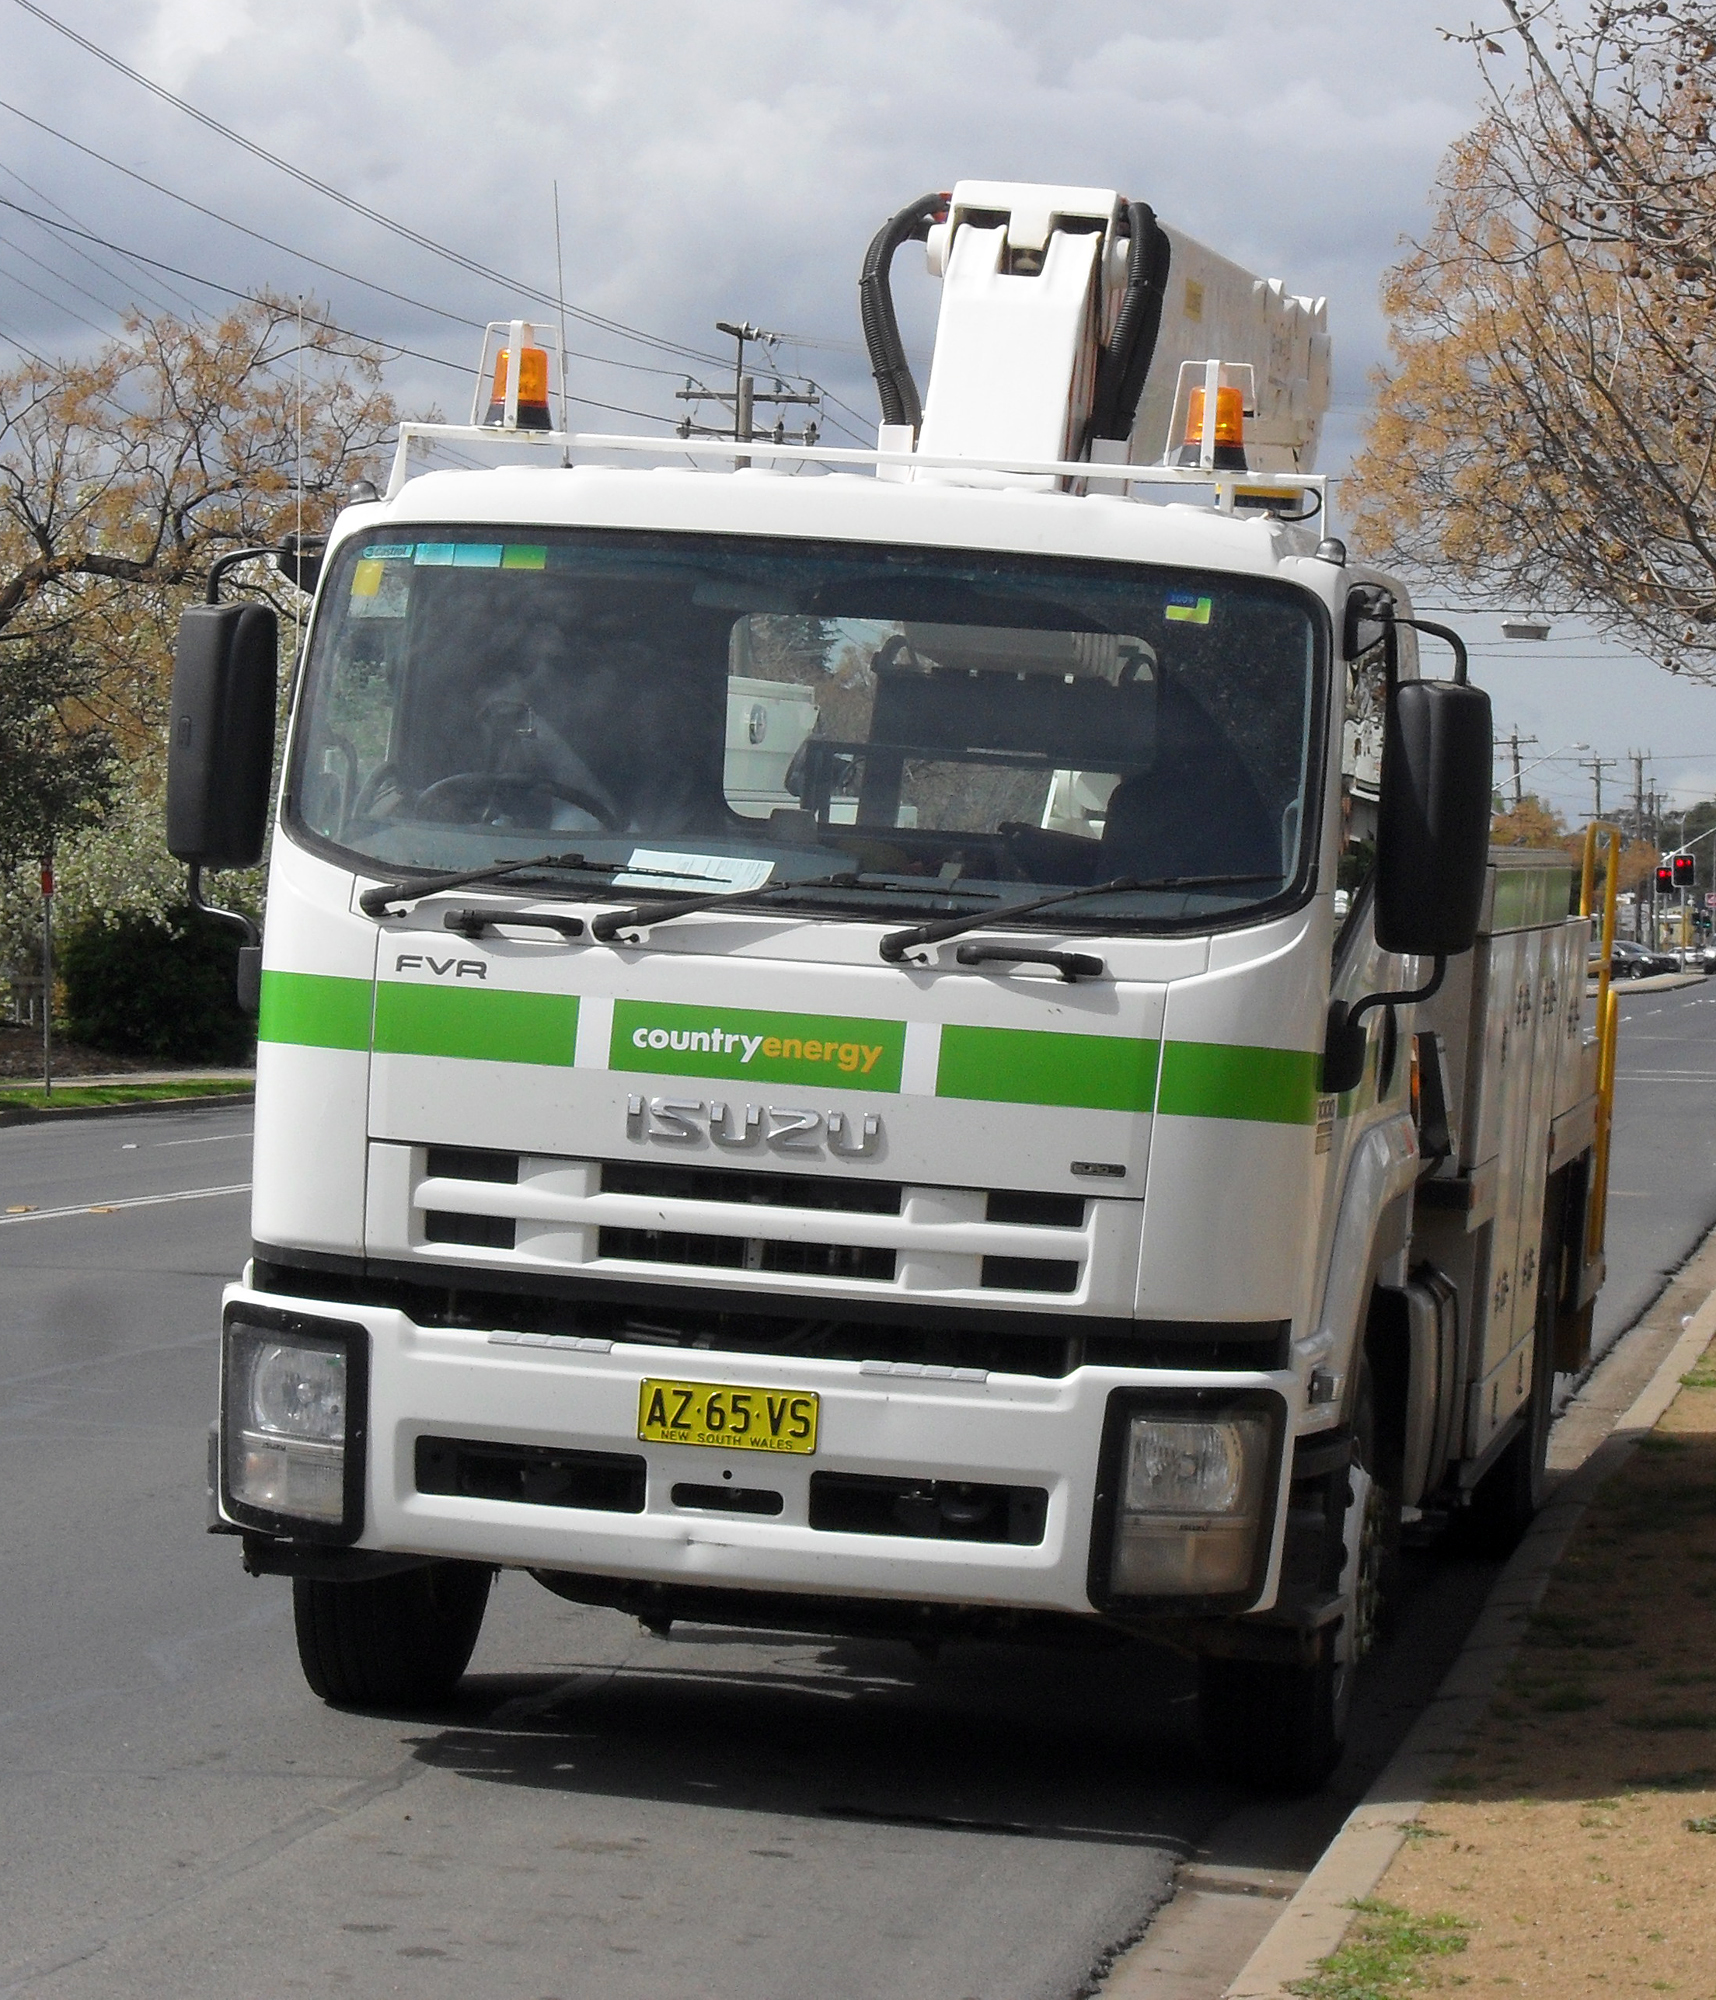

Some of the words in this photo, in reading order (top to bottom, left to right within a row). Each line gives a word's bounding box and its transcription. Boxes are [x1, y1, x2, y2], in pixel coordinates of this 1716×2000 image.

[395, 954, 487, 979] FVR
[632, 1027, 883, 1073] countryenergy
[626, 1093, 880, 1157] ISUZU
[661, 1430, 688, 1441] NEW
[697, 1433, 741, 1445] SOUTH
[750, 1437, 793, 1450] WALES
